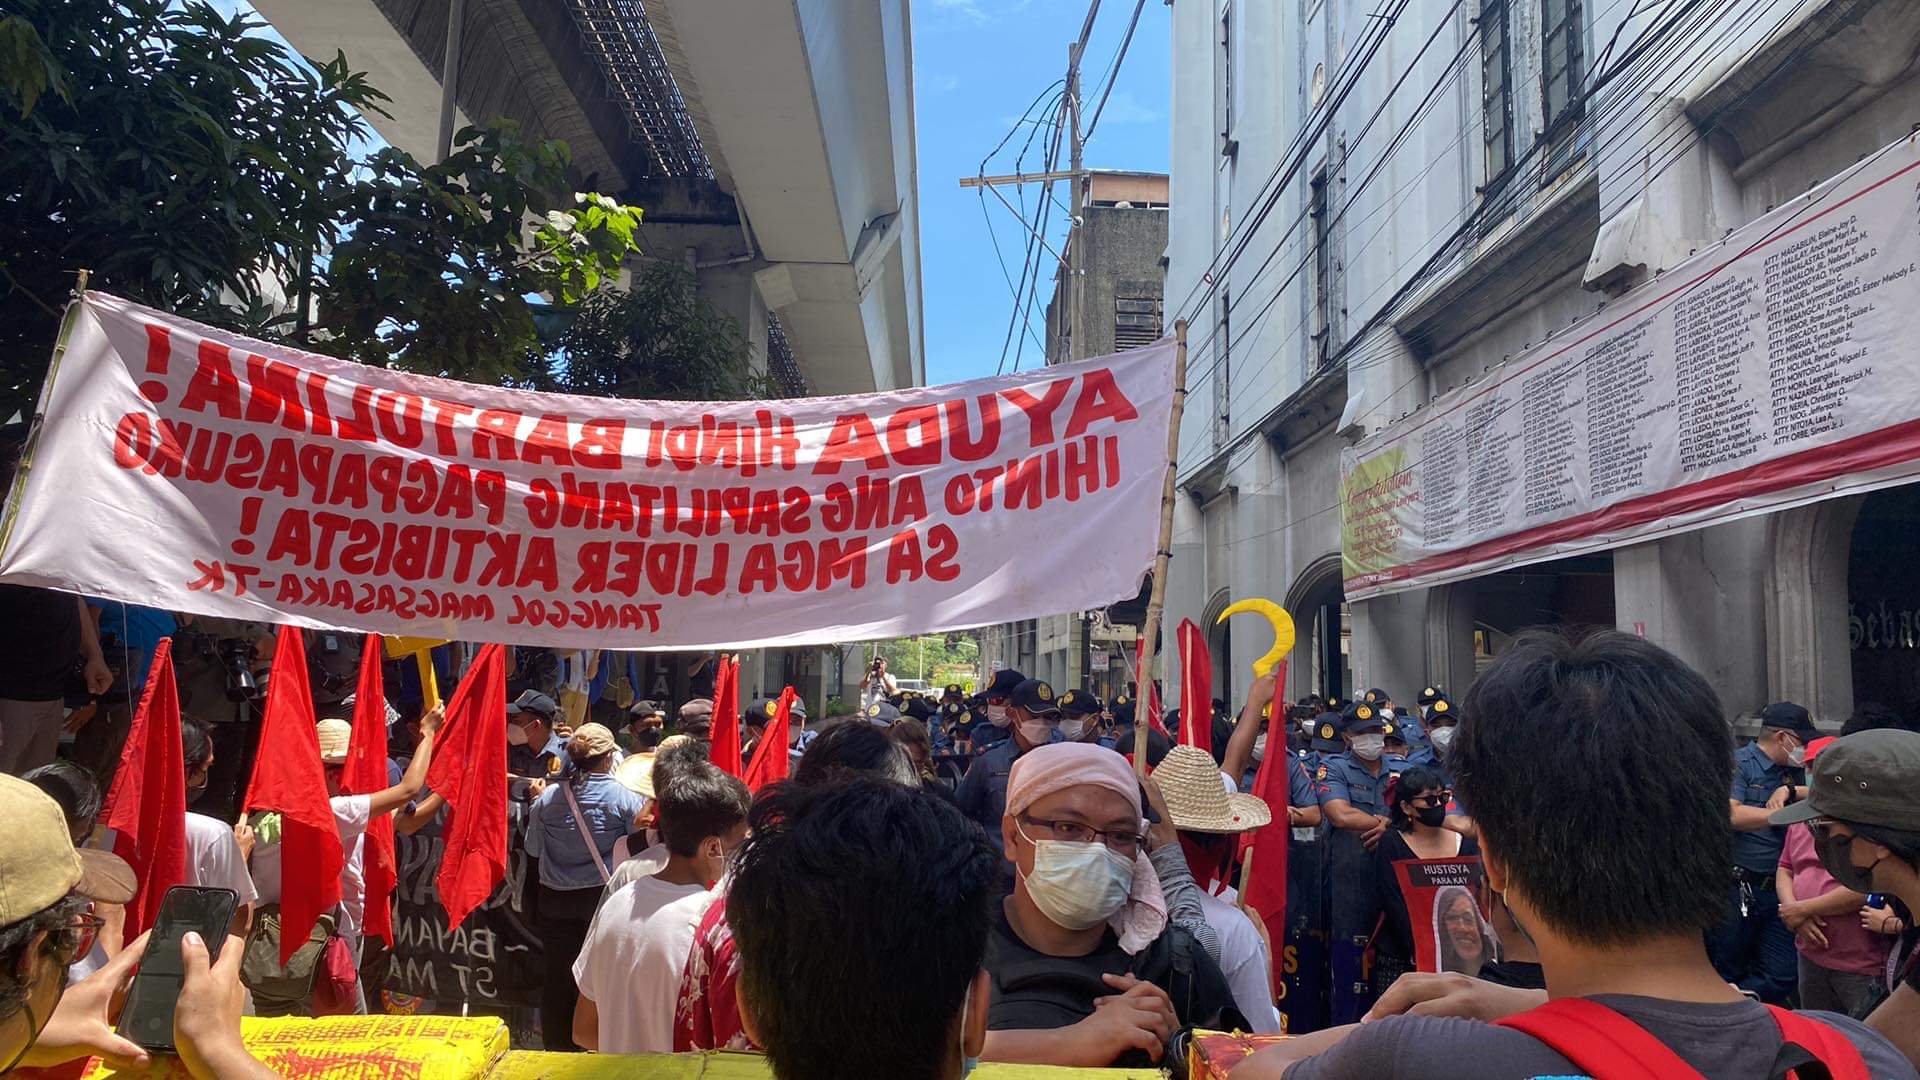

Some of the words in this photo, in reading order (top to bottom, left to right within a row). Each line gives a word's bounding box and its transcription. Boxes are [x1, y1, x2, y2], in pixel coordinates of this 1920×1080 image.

[1764, 262, 1779, 275] ATTY.
[1810, 236, 1833, 253] Andrew
[1764, 253, 1779, 265] ATTY.
[1765, 272, 1780, 285] ATTY.
[1827, 243, 1842, 255] Mary
[1765, 281, 1780, 294] ATTY.
[1782, 266, 1814, 286] MANALON
[1828, 250, 1849, 265] Nelson
[1766, 291, 1781, 303] ATTY.
[1829, 259, 1851, 275] Yvonne
[1766, 300, 1781, 312] ATTY.
[1768, 319, 1782, 331] ATTY.
[1882, 266, 1907, 284] Melody
[1767, 309, 1782, 321] ATTY.
[1769, 338, 1783, 350] ATTY.
[1846, 306, 1867, 319] Louise
[1768, 329, 1783, 340] ATTY.
[1769, 348, 1784, 359] ATTY.
[1830, 324, 1844, 336] Ruth
[1770, 357, 1785, 368] ATTY.
[1818, 335, 1843, 350] Michelle
[1770, 367, 1785, 378] ATTY.
[1771, 377, 1786, 387] ATTY.
[1822, 358, 1837, 369] Juan
[1839, 349, 1860, 363] Miguel
[1771, 386, 1786, 397] ATTY.
[1772, 396, 1787, 406] ATTY.
[1824, 379, 1839, 389] John
[1841, 371, 1862, 383] Patrick
[1773, 406, 1787, 416] ATTY.
[1811, 389, 1836, 404] Christine
[1773, 416, 1788, 425] ATTY.
[1808, 400, 1835, 415] Jefferson
[1774, 425, 1788, 435] ATTY.
[1774, 435, 1789, 444] ATTY.
[1811, 423, 1829, 434] Simon
[1423, 864, 1470, 875] HUSTISYA
[1431, 876, 1450, 886] PARA
[1452, 876, 1468, 886] KAY
